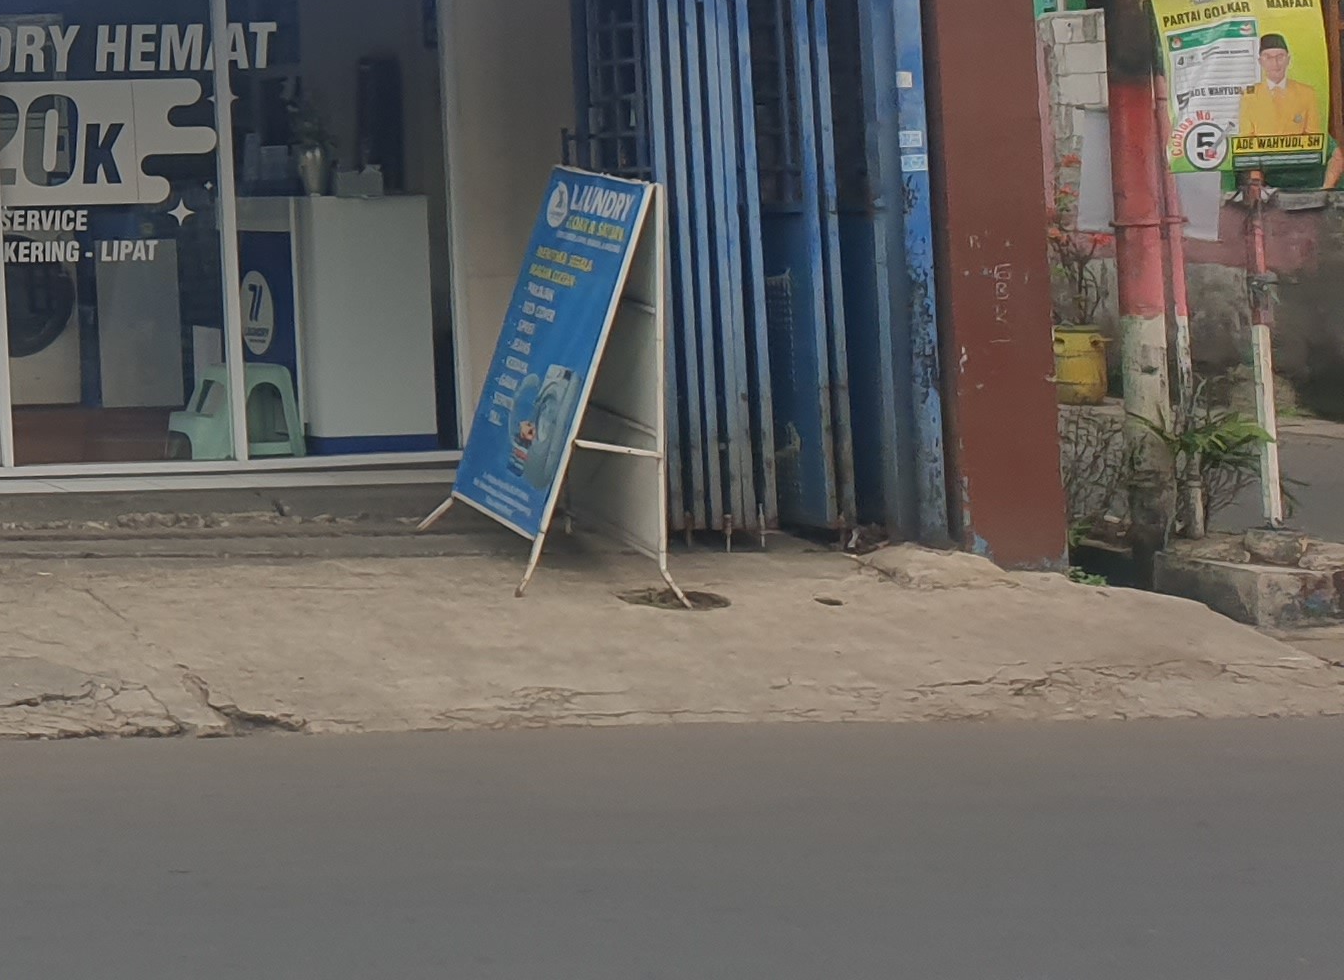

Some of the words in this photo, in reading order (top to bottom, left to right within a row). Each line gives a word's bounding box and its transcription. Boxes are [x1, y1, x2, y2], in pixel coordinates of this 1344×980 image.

[1163, 11, 1201, 27] PARTAI
[1204, 1, 1251, 19] GOLKAR
[95, 21, 278, 73] HEMAT
[1171, 118, 1193, 157] Coblos
[1196, 132, 1216, 161] 5
[1236, 137, 1253, 150] ADE
[1307, 136, 1320, 147] SH
[2, 209, 88, 232] SERVICE
[3, 239, 80, 263] KERING
[100, 239, 159, 262] LIPAT
